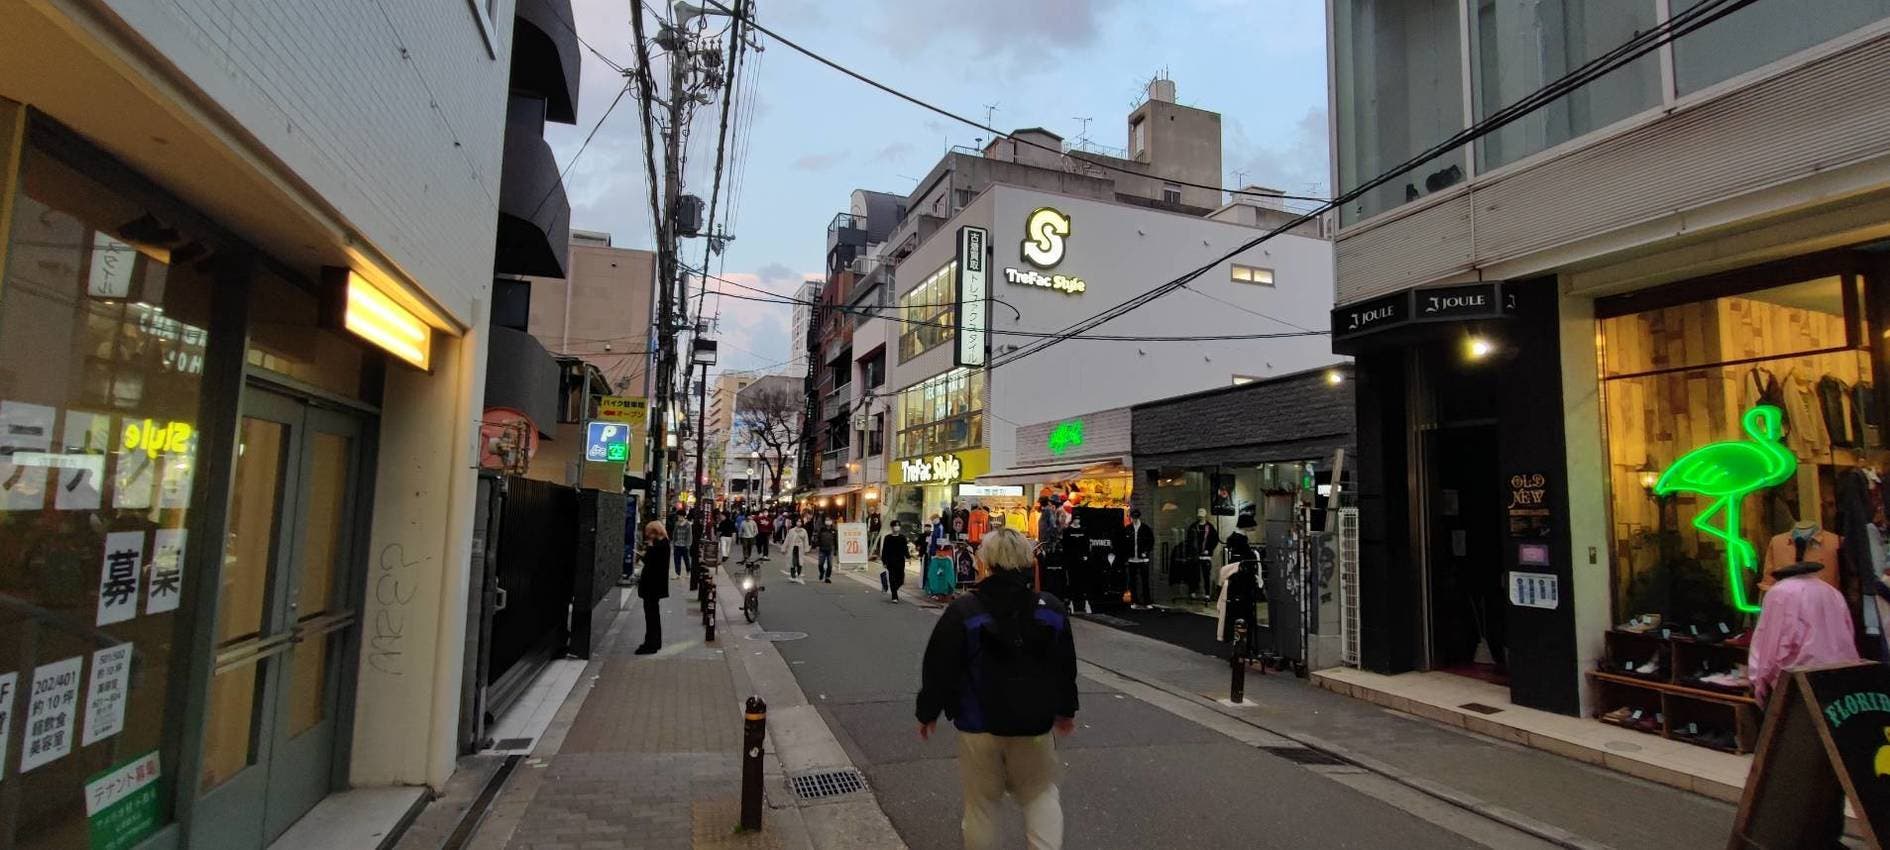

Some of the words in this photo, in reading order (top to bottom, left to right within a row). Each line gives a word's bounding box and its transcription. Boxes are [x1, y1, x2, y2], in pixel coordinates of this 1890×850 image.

[1004, 267, 1052, 287] TreFac
[1052, 274, 1086, 294] Style
[1442, 294, 1486, 310] JOULE
[1362, 305, 1395, 325] JOULE
[601, 426, 617, 442] P
[902, 459, 931, 483] TreFac
[933, 455, 960, 485] Style
[1511, 474, 1545, 488] OLD
[1507, 488, 1545, 509] NEW
[35, 671, 76, 695] 202/401
